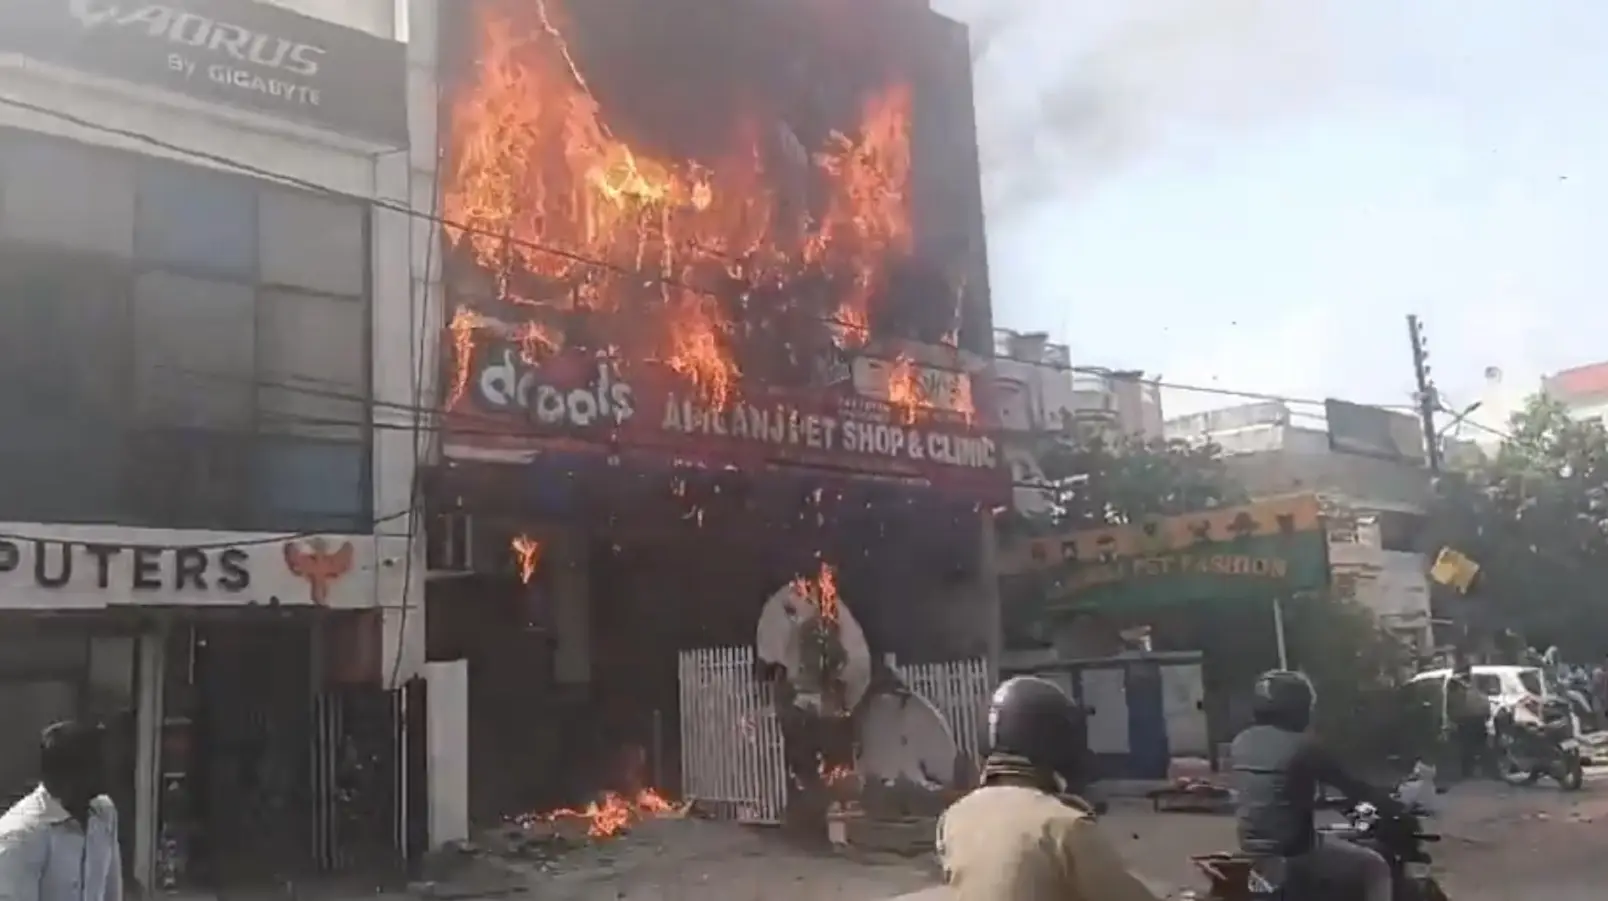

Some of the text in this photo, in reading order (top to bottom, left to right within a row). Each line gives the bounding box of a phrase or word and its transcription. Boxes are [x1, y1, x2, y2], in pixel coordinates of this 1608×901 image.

[117, 4, 326, 77] AORUS
[208, 64, 323, 106] GIGABYTE
[842, 421, 904, 457] SHOP
[907, 429, 925, 460] &
[927, 431, 997, 469] CLINIC
